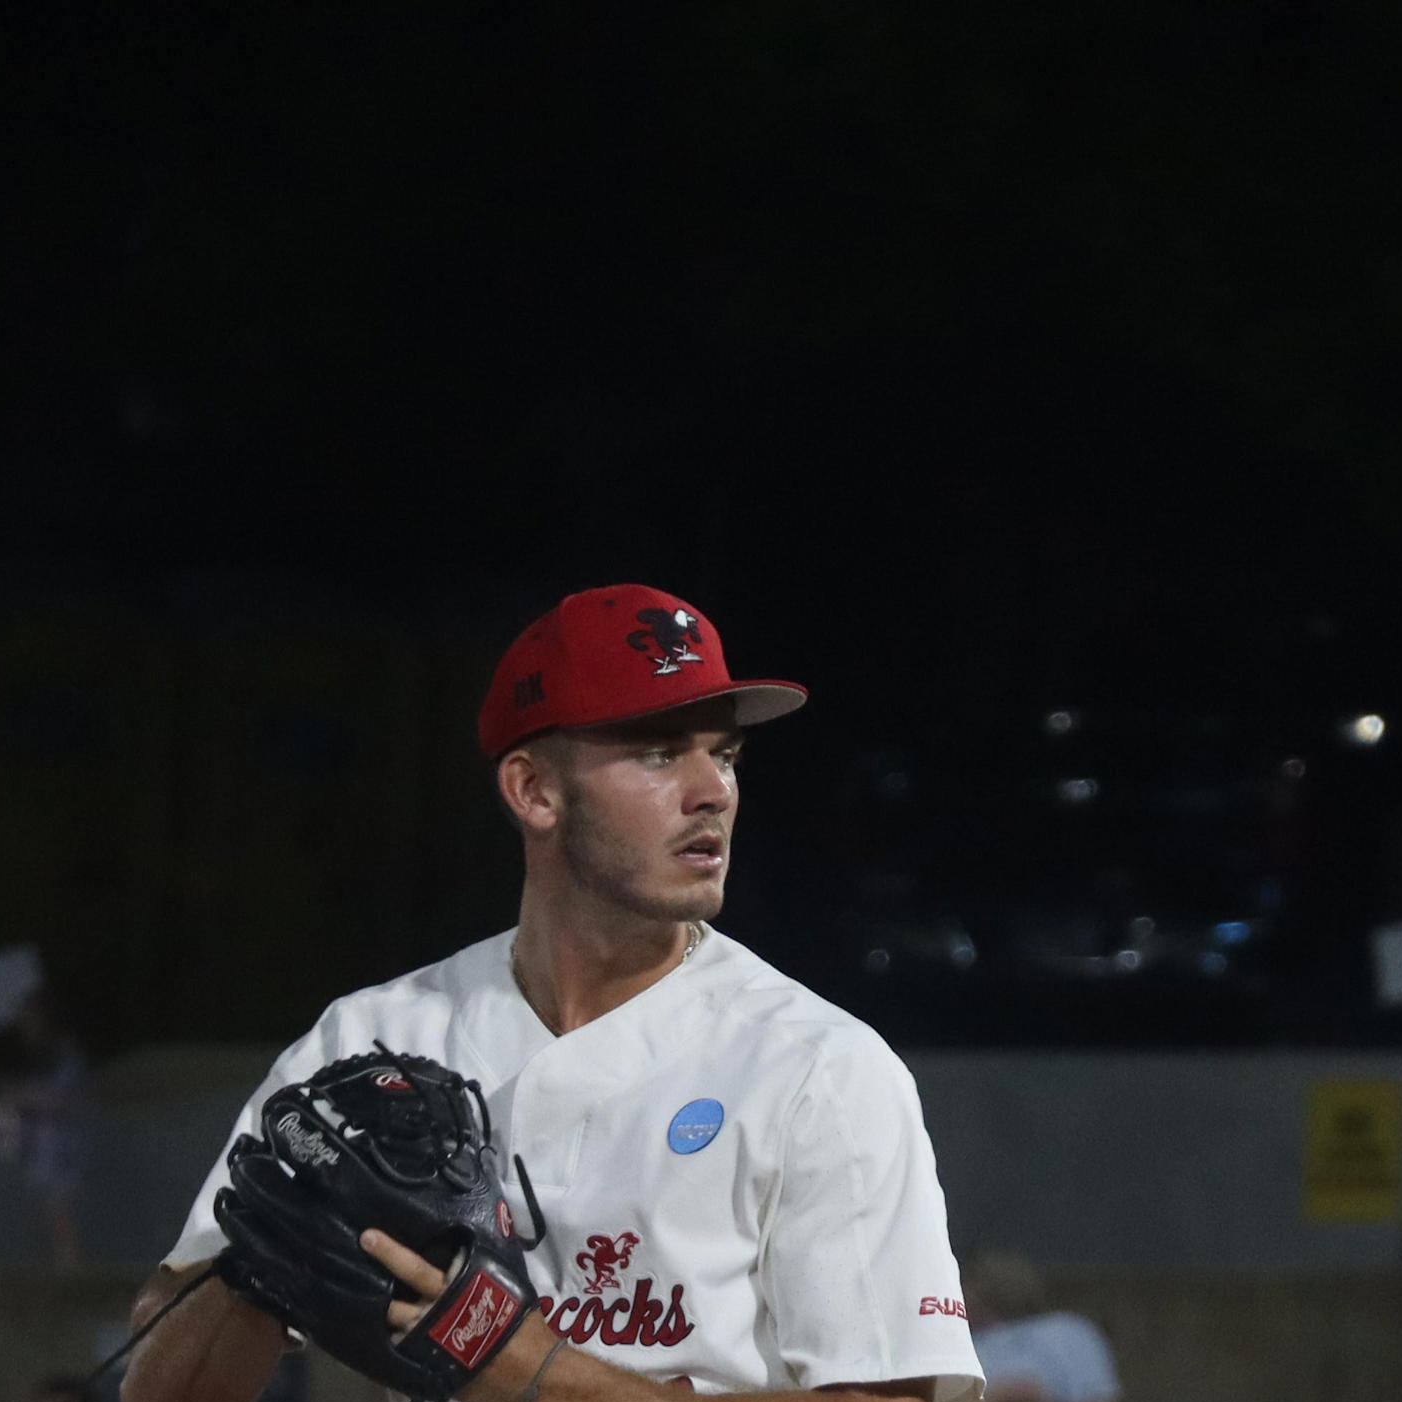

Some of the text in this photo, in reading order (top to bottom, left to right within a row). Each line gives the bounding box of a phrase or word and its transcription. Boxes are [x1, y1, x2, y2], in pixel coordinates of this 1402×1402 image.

[277, 1110, 340, 1168] Rawlings
[451, 1286, 496, 1352] Rawlings
[537, 1277, 695, 1346] cocks
